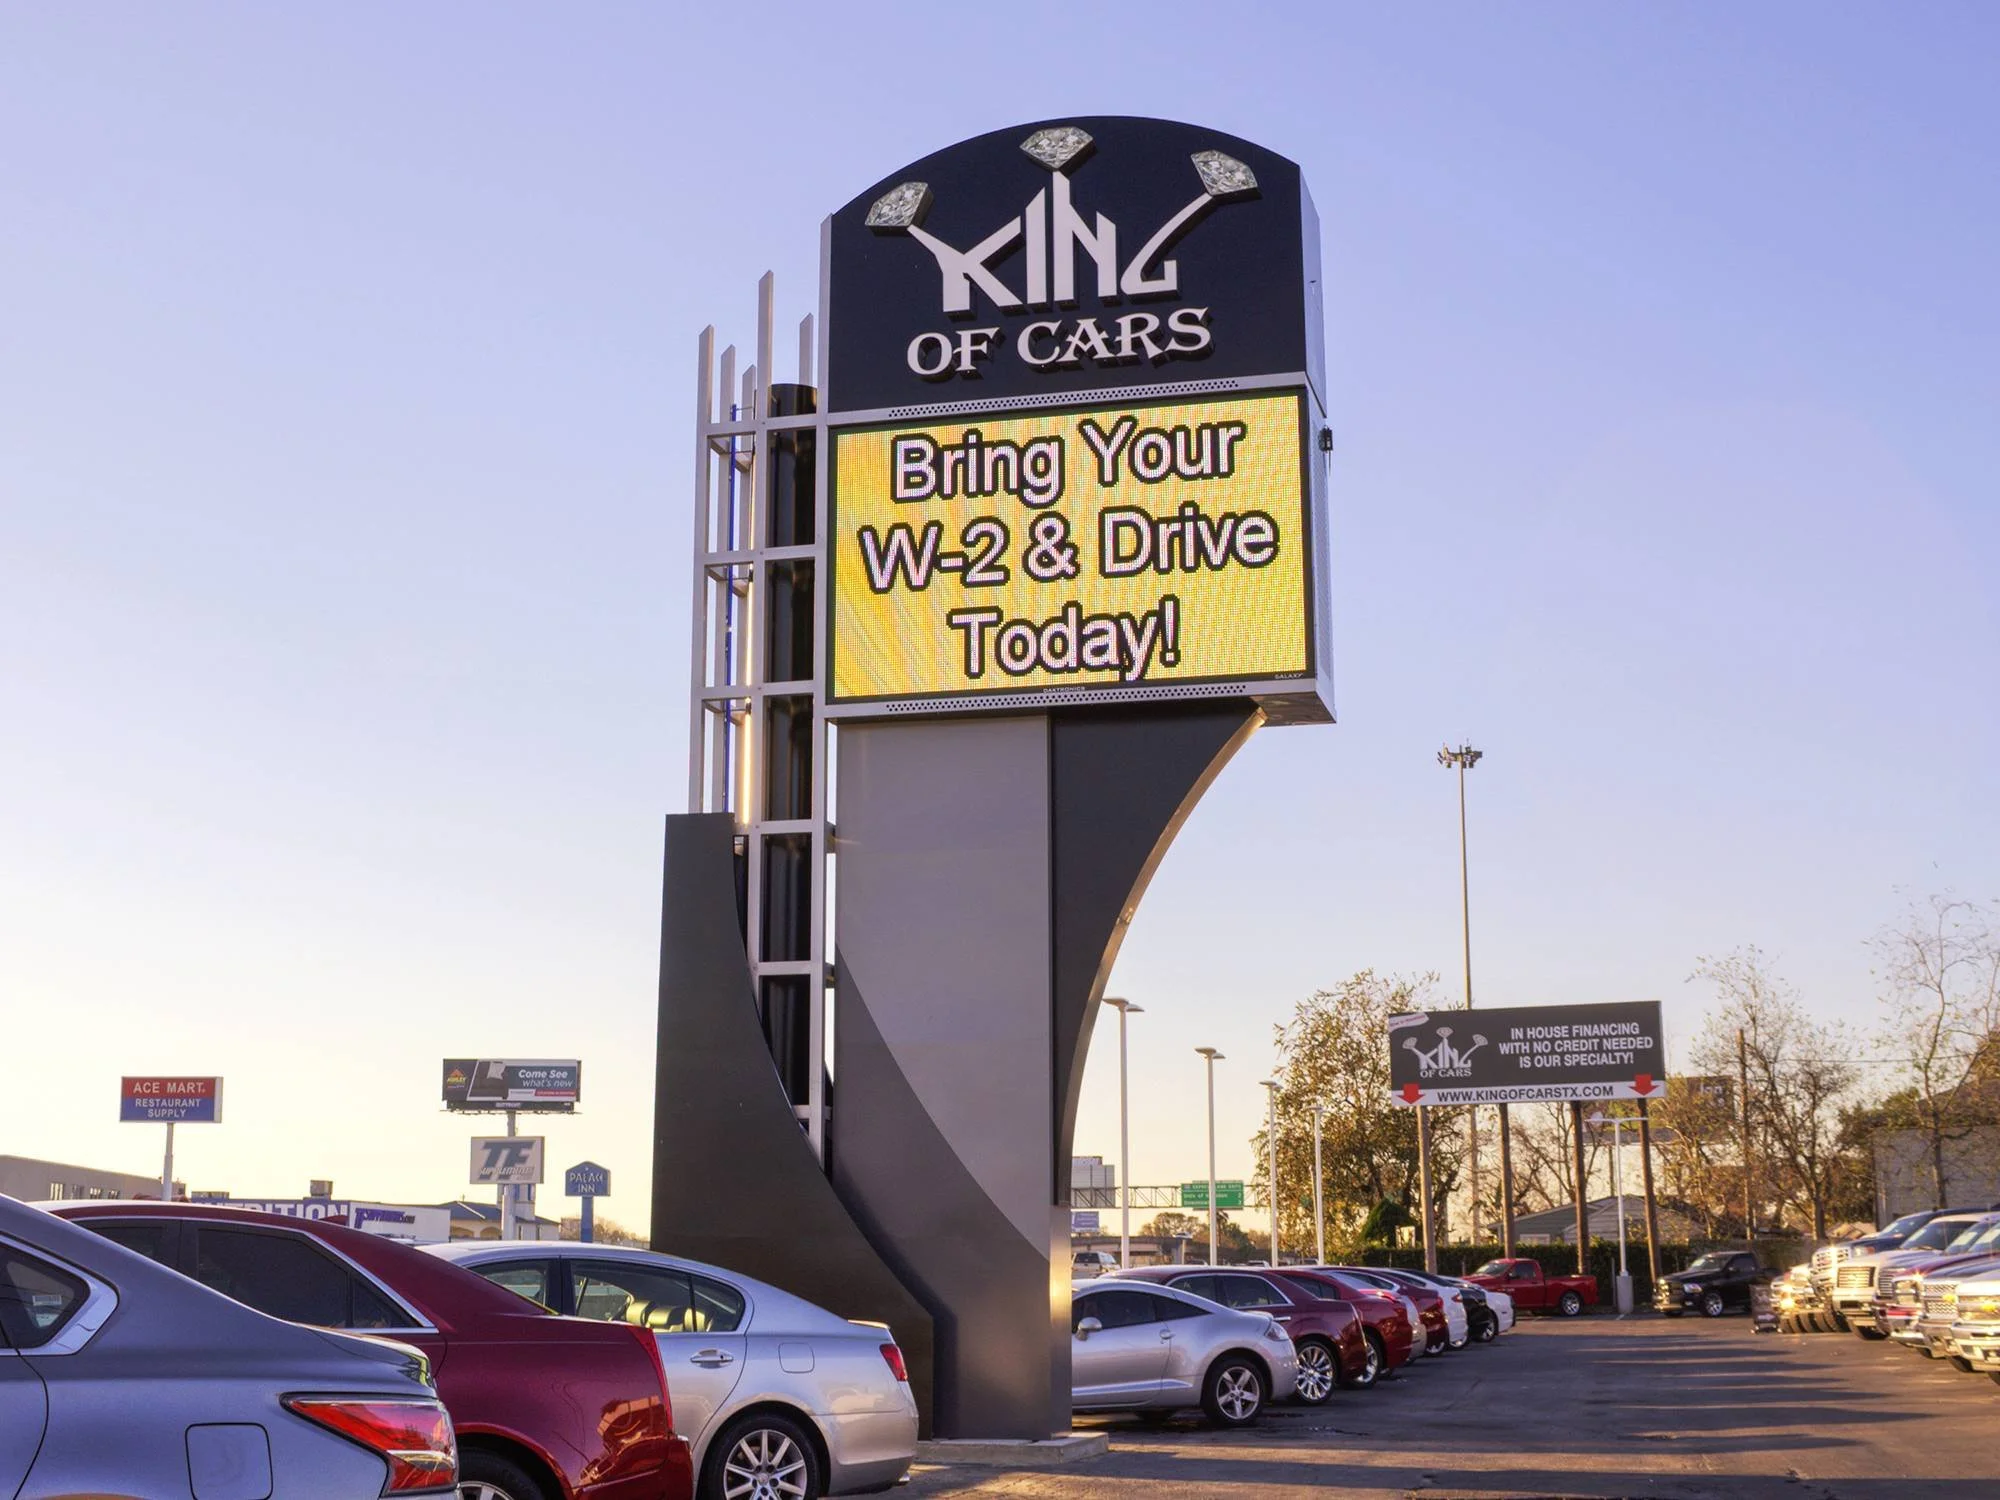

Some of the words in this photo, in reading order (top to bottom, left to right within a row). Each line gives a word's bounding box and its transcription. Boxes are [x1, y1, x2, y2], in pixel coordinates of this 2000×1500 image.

[906, 170, 1214, 313] KING
[906, 327, 1000, 376] OF
[1016, 307, 1214, 366] CARS
[891, 429, 1064, 508] Bring
[1078, 416, 1248, 487] Your
[857, 517, 1010, 593] W-2
[1023, 511, 1080, 581] &
[1100, 501, 1279, 578] Drive
[947, 594, 1181, 683] Today!
[1510, 1028, 1524, 1040] IN
[1526, 1026, 1569, 1039] HOUSE
[1572, 1022, 1640, 1037] FINANCING
[1499, 1042, 1530, 1055] WITH
[1533, 1041, 1551, 1054] NO
[1554, 1039, 1600, 1052] CREDIT
[1602, 1036, 1654, 1051] NEEDED
[1519, 1056, 1532, 1069] IS
[1534, 1055, 1561, 1068] OUR
[1564, 1052, 1634, 1067] SPECIALTY!
[518, 1069, 547, 1079] Come
[549, 1069, 569, 1079] See
[1420, 1069, 1436, 1079] OF
[1438, 1068, 1473, 1078] CARS
[133, 1082, 160, 1094] ACE
[522, 1079, 552, 1088] what's
[553, 1080, 573, 1088] new
[1437, 1085, 1614, 1103] WWW.KINGOFCARSTX.COM
[135, 1098, 202, 1108] RESTAURANT
[147, 1109, 186, 1118] SUPPLY
[578, 1184, 596, 1193] INN
